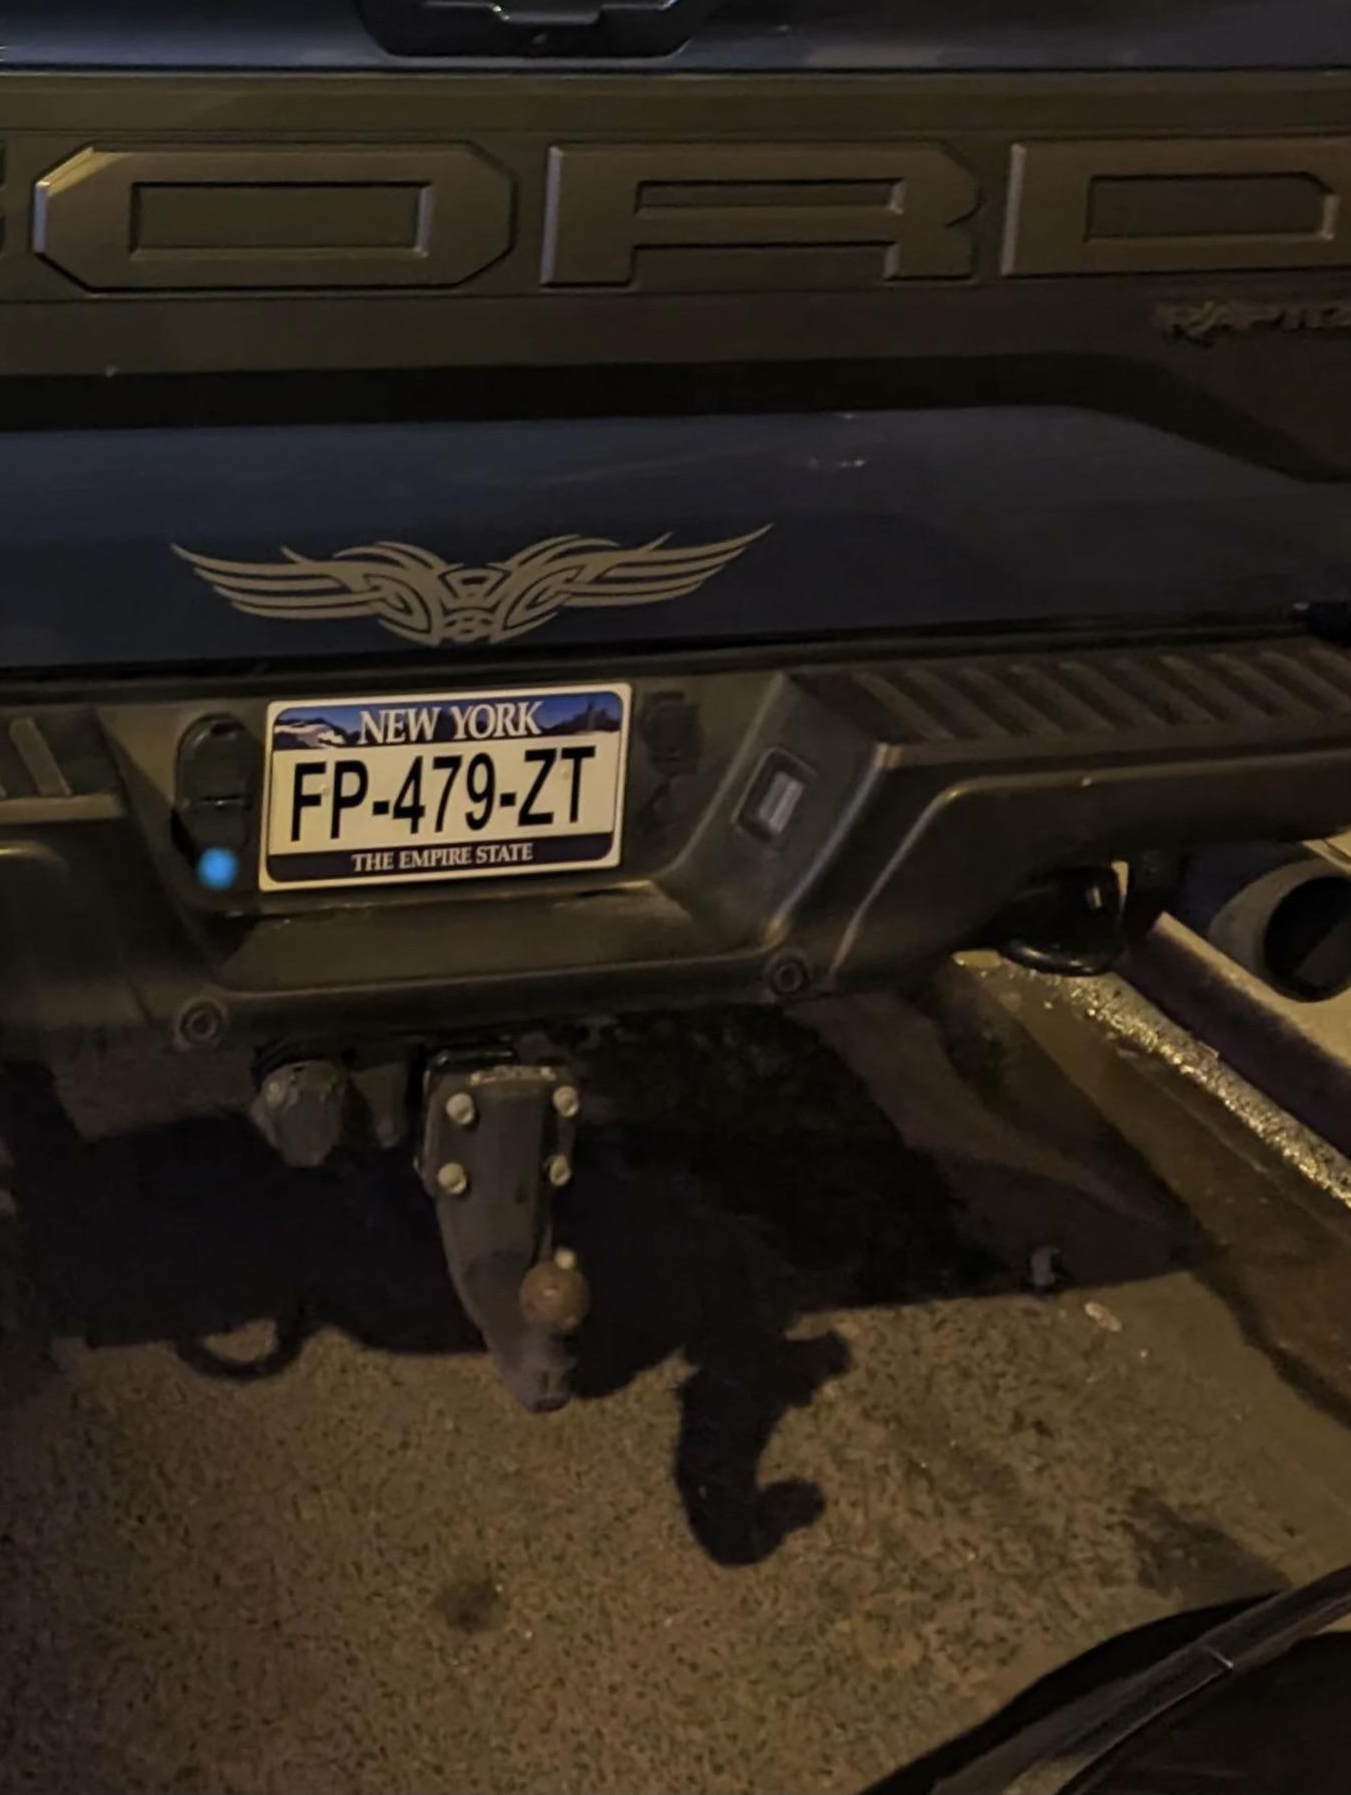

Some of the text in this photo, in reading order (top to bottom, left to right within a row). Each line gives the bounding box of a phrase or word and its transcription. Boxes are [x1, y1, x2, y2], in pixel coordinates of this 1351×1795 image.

[357, 701, 544, 746] NEW YORK
[289, 745, 597, 842] FP-479-ZT
[352, 842, 534, 873] THE EMPIRE STATE
